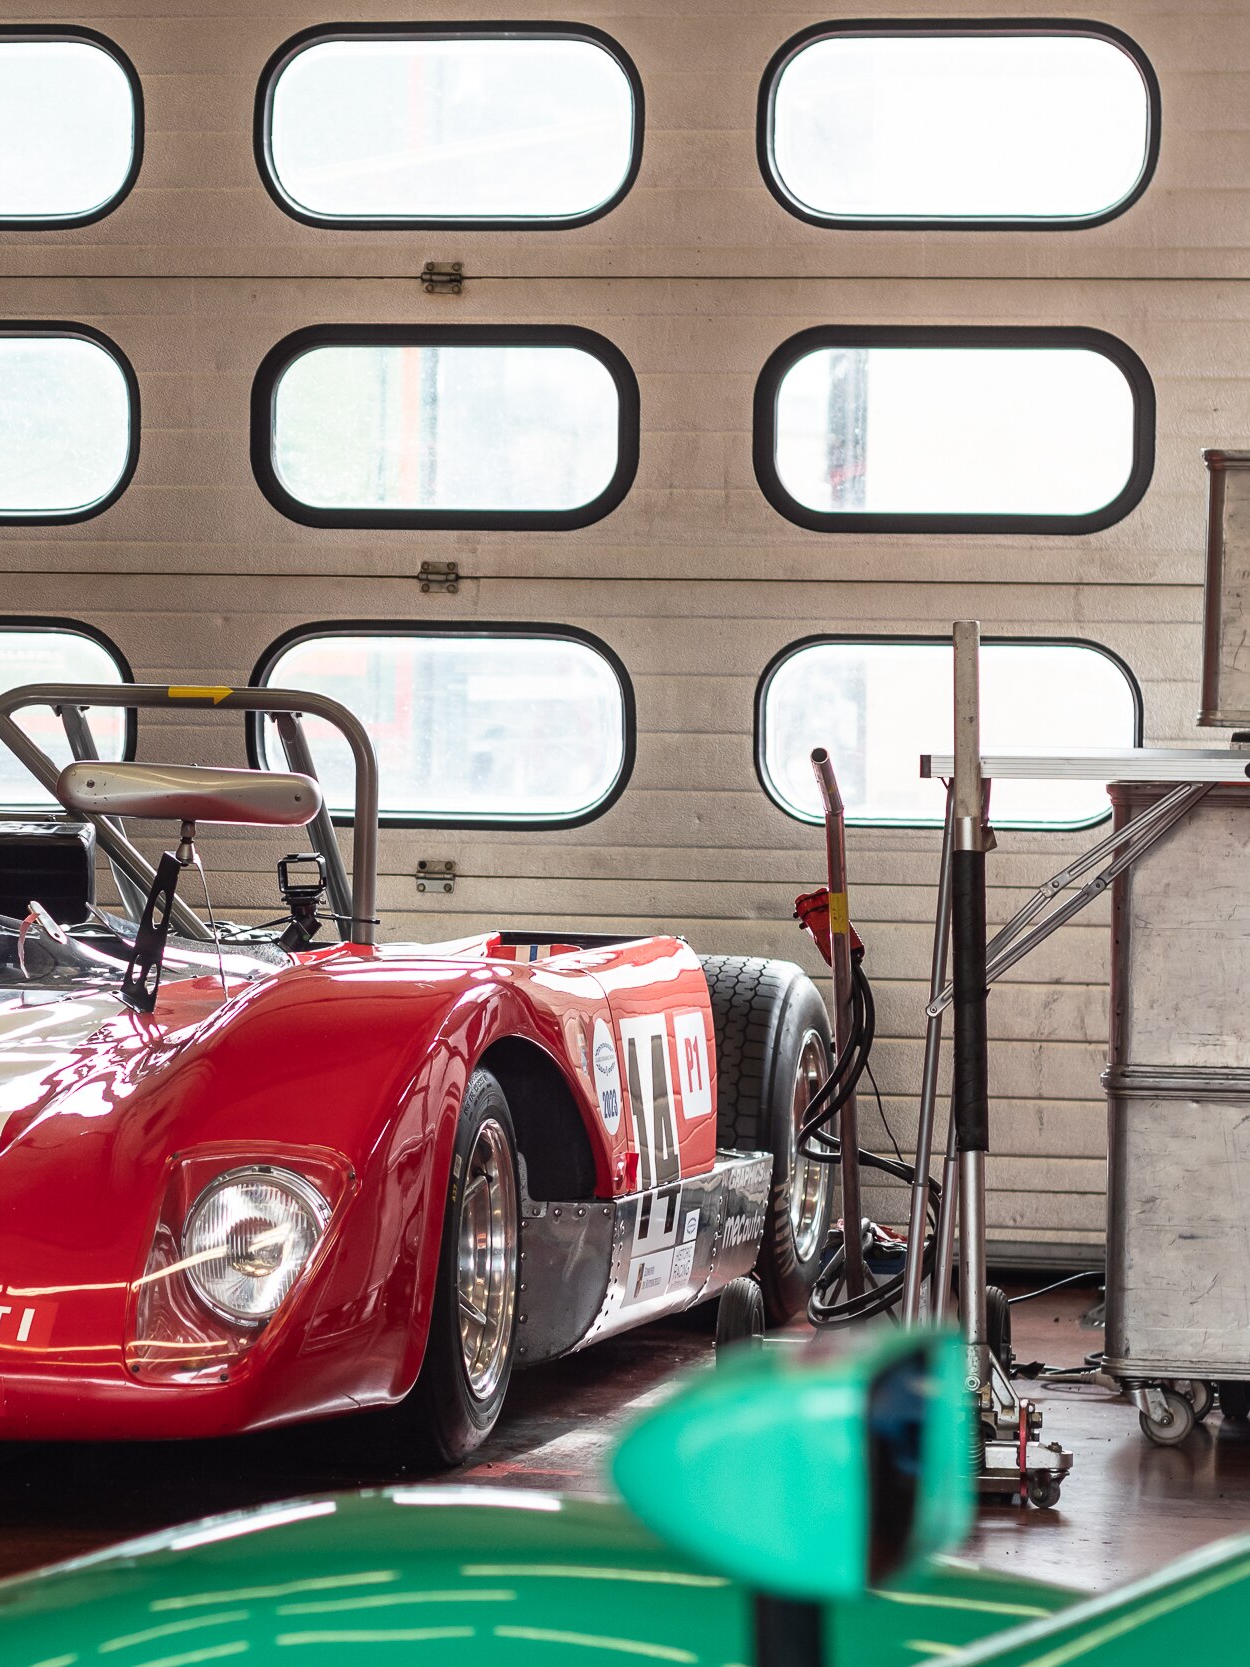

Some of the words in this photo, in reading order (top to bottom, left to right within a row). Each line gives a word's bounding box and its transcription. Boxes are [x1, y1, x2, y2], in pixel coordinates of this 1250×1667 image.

[684, 1035, 703, 1093] P1
[602, 1088, 619, 1119] 2023
[627, 1033, 681, 1240] 14
[722, 1209, 761, 1250] mecauto
